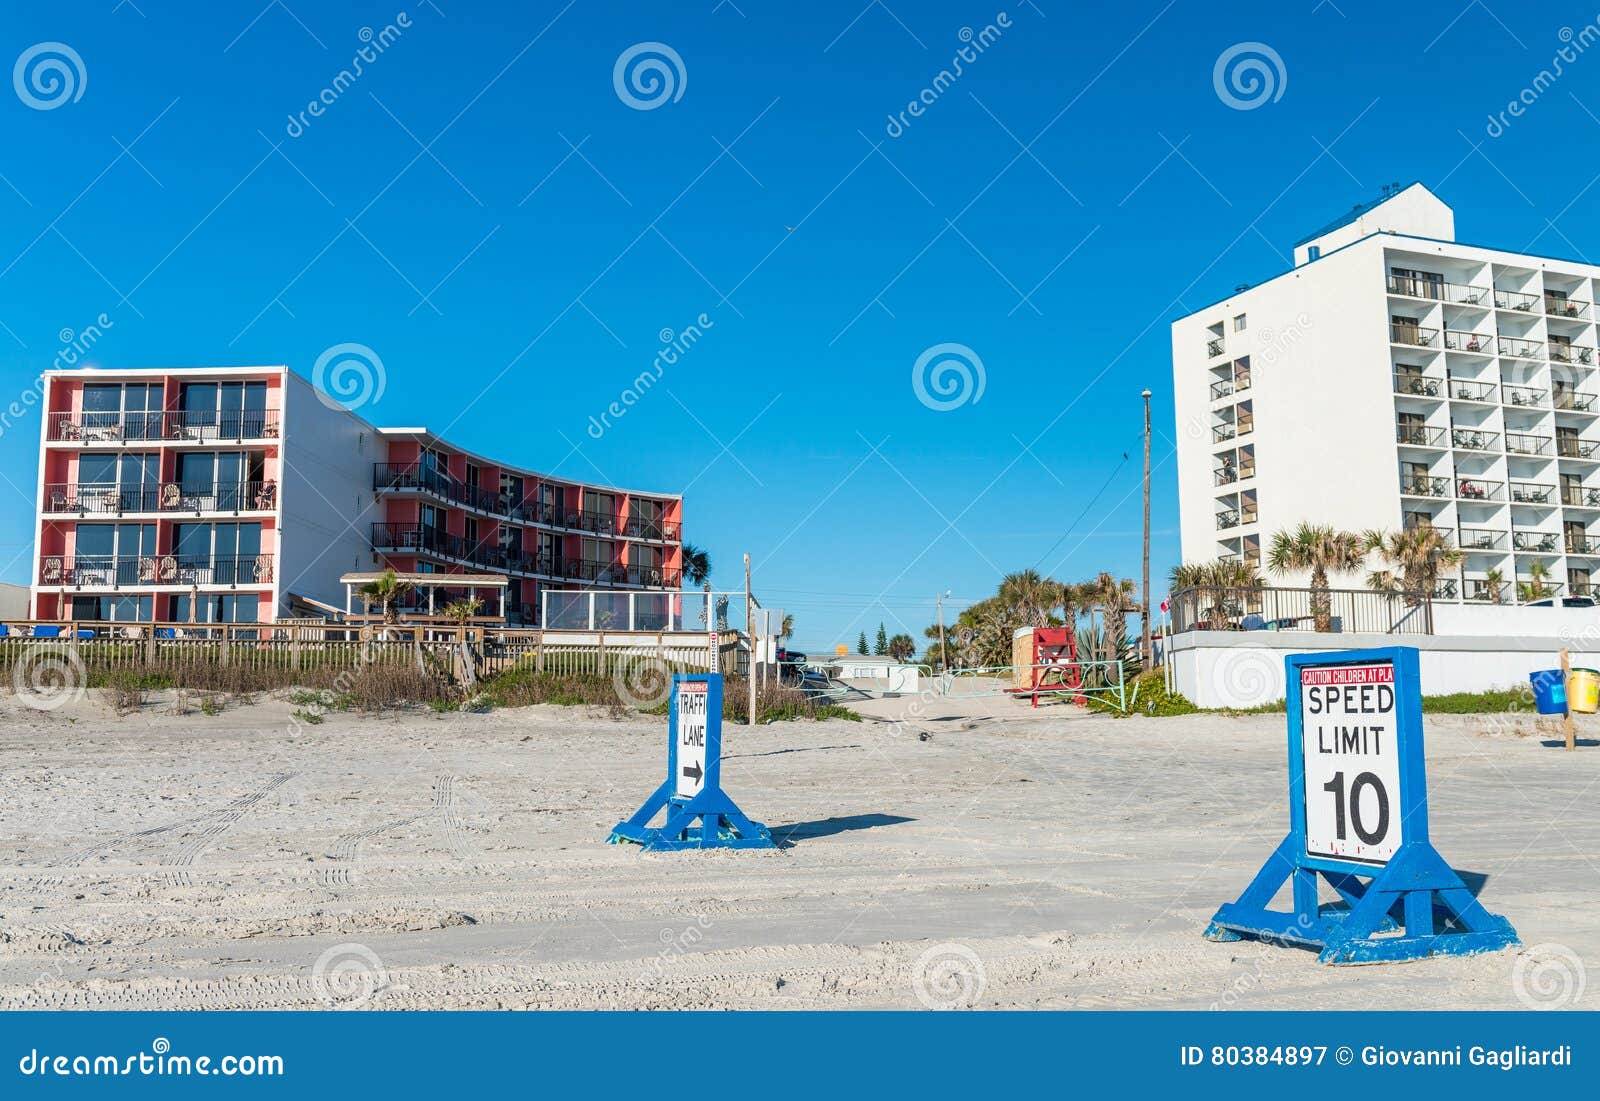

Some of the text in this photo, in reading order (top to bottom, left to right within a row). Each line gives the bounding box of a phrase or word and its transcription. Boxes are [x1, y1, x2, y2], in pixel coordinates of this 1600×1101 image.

[1303, 668, 1393, 684] CAUTION CHILDREN AT PLA
[680, 693, 707, 716] TRAFFI
[1309, 685, 1394, 714] SPEED
[683, 725, 704, 747] LANE
[1318, 726, 1384, 755] LIMIT
[1323, 771, 1390, 846] 10
